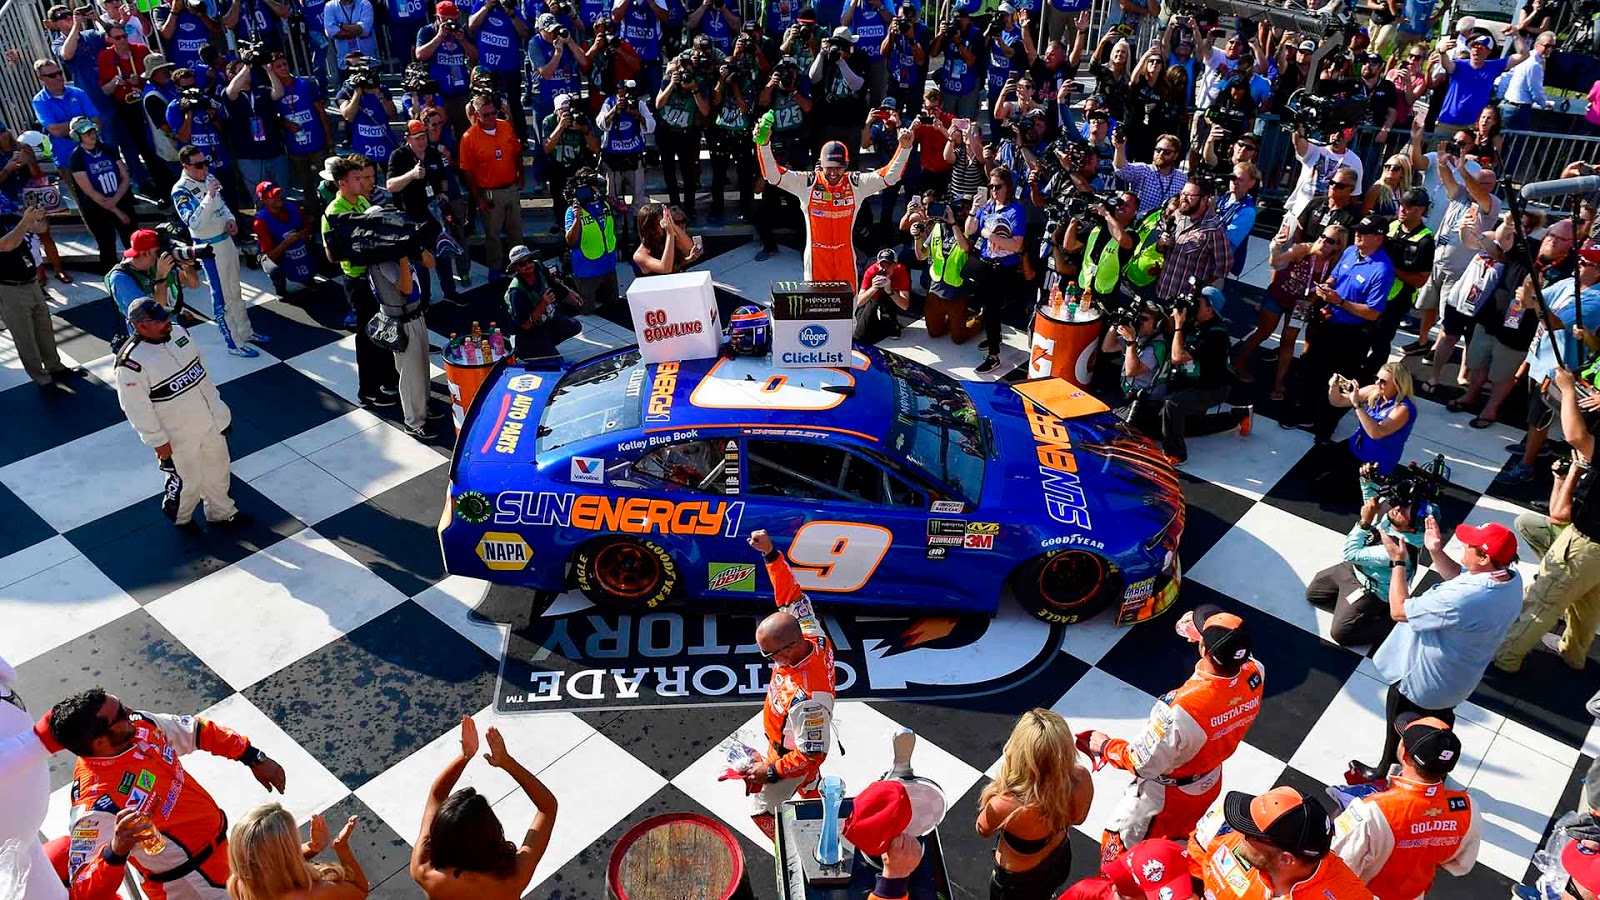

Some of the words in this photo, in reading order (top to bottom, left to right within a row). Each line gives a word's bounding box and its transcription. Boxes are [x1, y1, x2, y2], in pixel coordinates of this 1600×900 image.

[481, 32, 509, 47] PHOTO
[857, 26, 885, 37] PHOTO
[485, 53, 500, 65] 187
[944, 79, 962, 92] 269
[775, 105, 802, 128] 125
[358, 124, 387, 137] PHOTO
[365, 144, 385, 158] 219
[98, 171, 118, 194] 110
[296, 264, 309, 276] 18
[804, 296, 841, 305] MONSTER
[645, 309, 667, 328] GO
[643, 320, 703, 344] BOWLING
[801, 328, 827, 346] Kroger
[781, 352, 844, 364] ClickList
[169, 363, 204, 392] OFFICIAL
[626, 369, 646, 397] ELLIOTT
[507, 393, 534, 420] AUTO
[495, 420, 524, 454] PARTS
[618, 439, 647, 452] Kelley
[649, 434, 672, 446] Blue
[673, 429, 699, 441] Book
[574, 474, 600, 482] Valvoline
[494, 490, 745, 538] SUNENERGY1
[965, 534, 993, 549] 3M
[1041, 533, 1105, 550] GOODYEAR
[484, 542, 525, 561] NAPA
[787, 520, 894, 593] 9
[577, 553, 592, 592] EAGLE
[645, 540, 677, 608] GOODYEAR
[1038, 608, 1079, 624] EAGLE
[1234, 648, 1247, 660] 9
[1227, 677, 1239, 688] 9
[1210, 695, 1260, 728] GUSTAFSON
[1438, 749, 1455, 761] 9
[1424, 786, 1438, 797] 9
[1411, 820, 1458, 834] GOLDER
